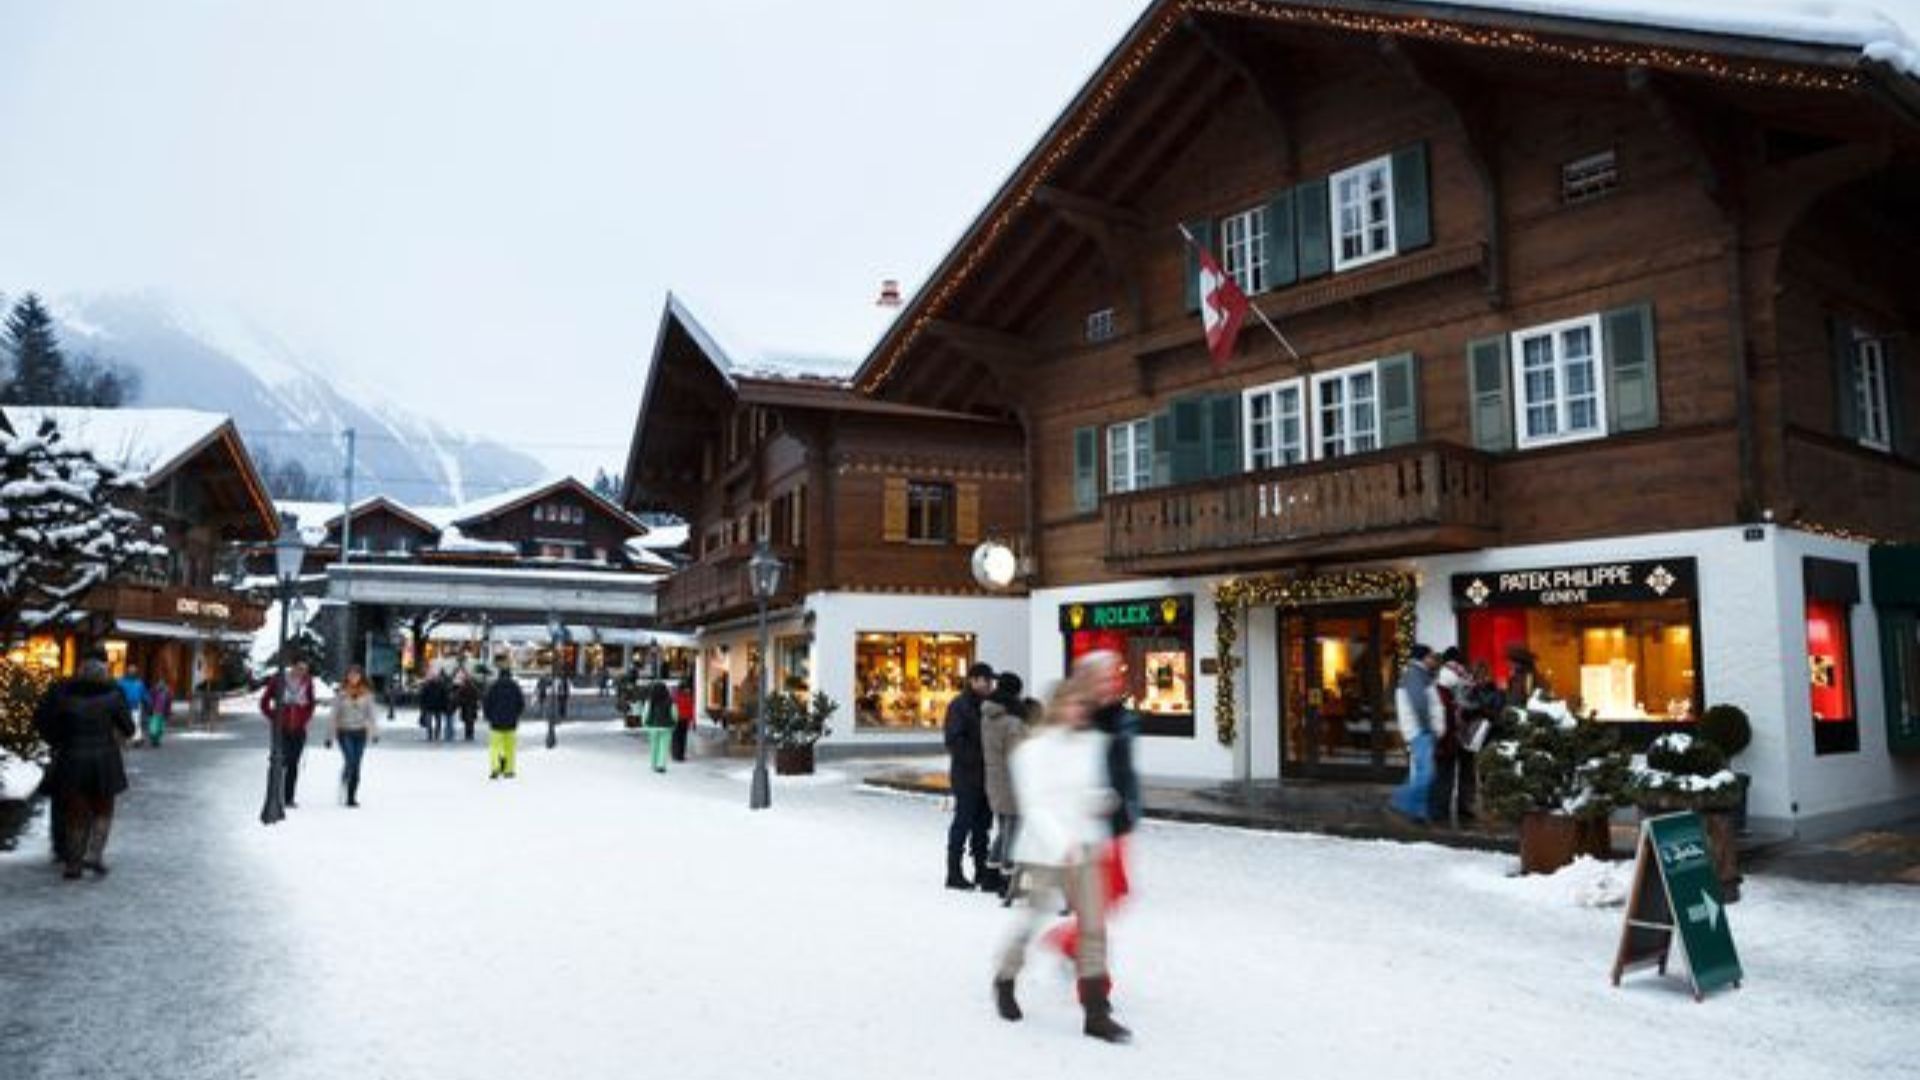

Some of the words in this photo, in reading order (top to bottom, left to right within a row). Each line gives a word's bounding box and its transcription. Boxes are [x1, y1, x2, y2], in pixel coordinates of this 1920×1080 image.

[1500, 571, 1551, 591] PATEK
[1553, 565, 1633, 587] PHILIPPE
[1094, 605, 1150, 626] ROLEX
